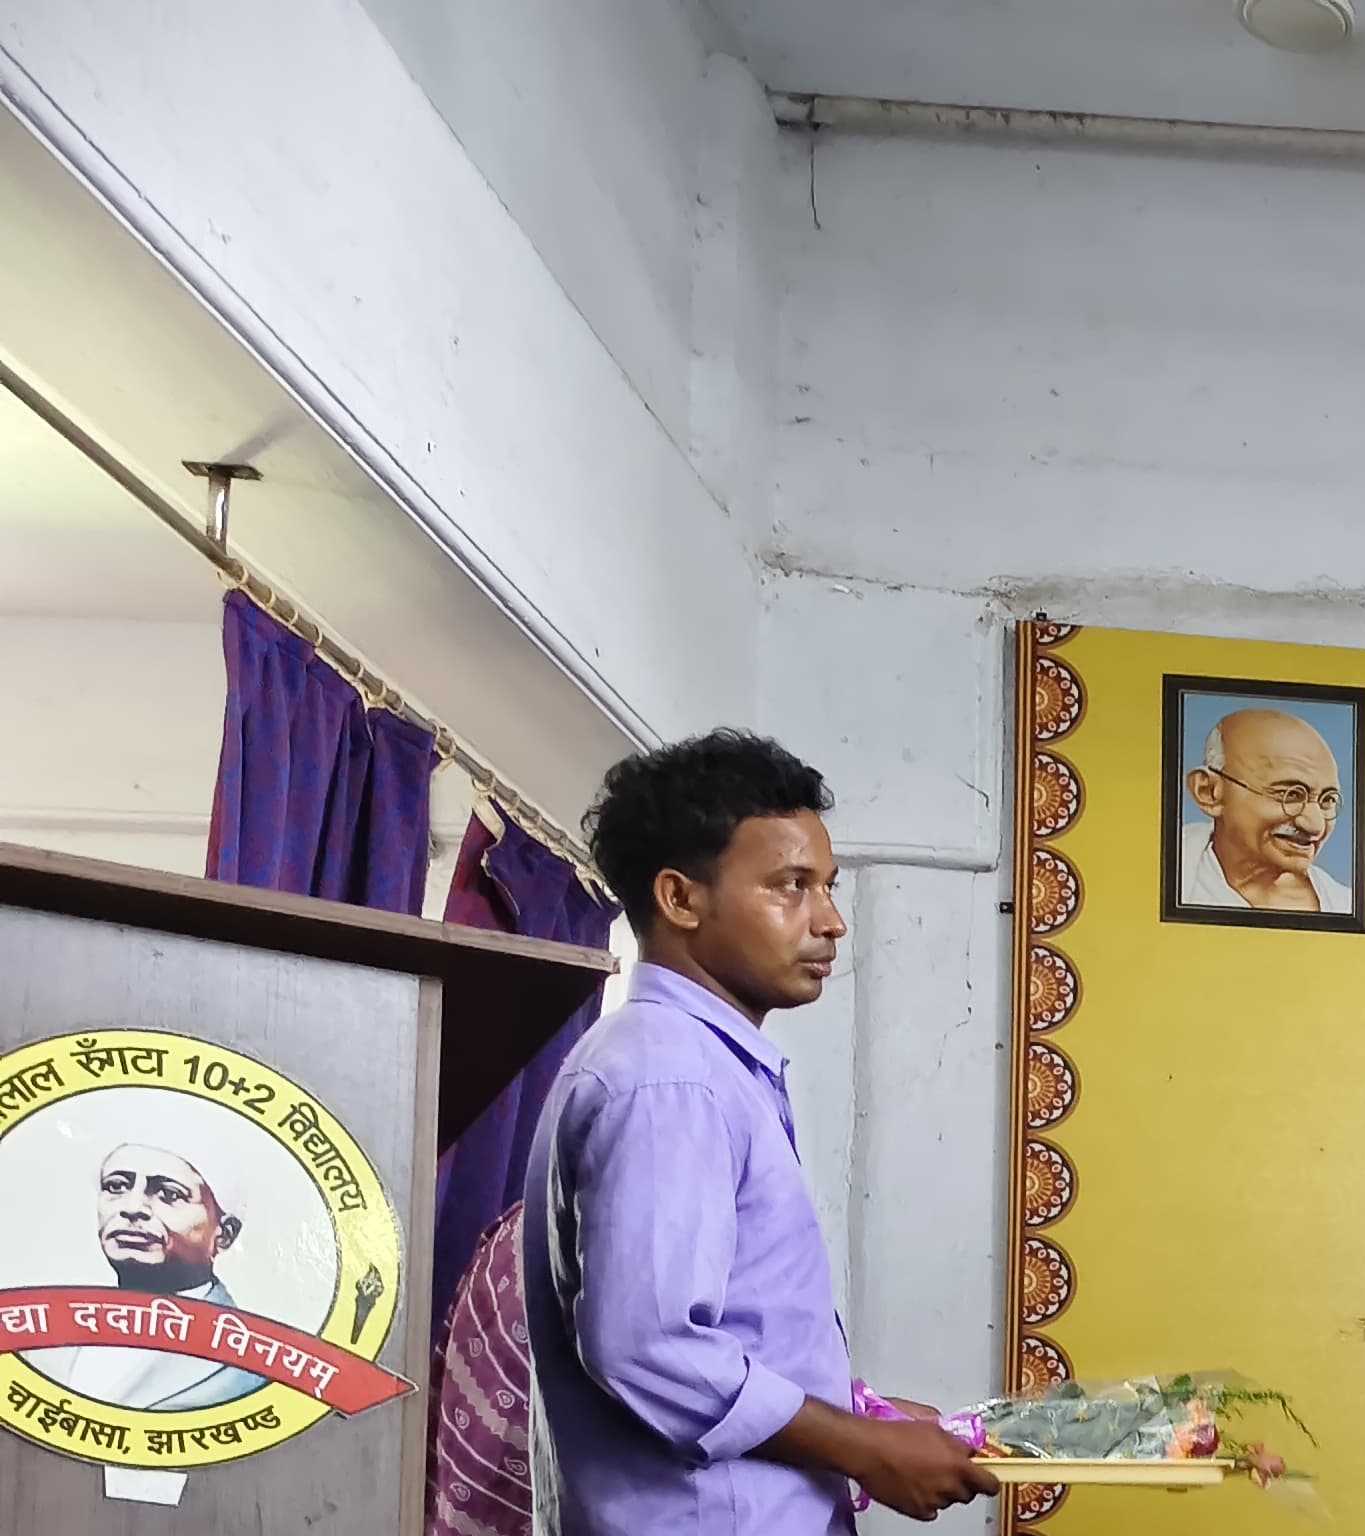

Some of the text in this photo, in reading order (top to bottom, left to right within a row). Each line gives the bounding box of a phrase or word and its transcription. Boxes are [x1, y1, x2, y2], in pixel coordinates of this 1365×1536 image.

[183, 1054, 277, 1116] 10+2
[0, 1298, 340, 1398] द्या ददाति विनयम्
